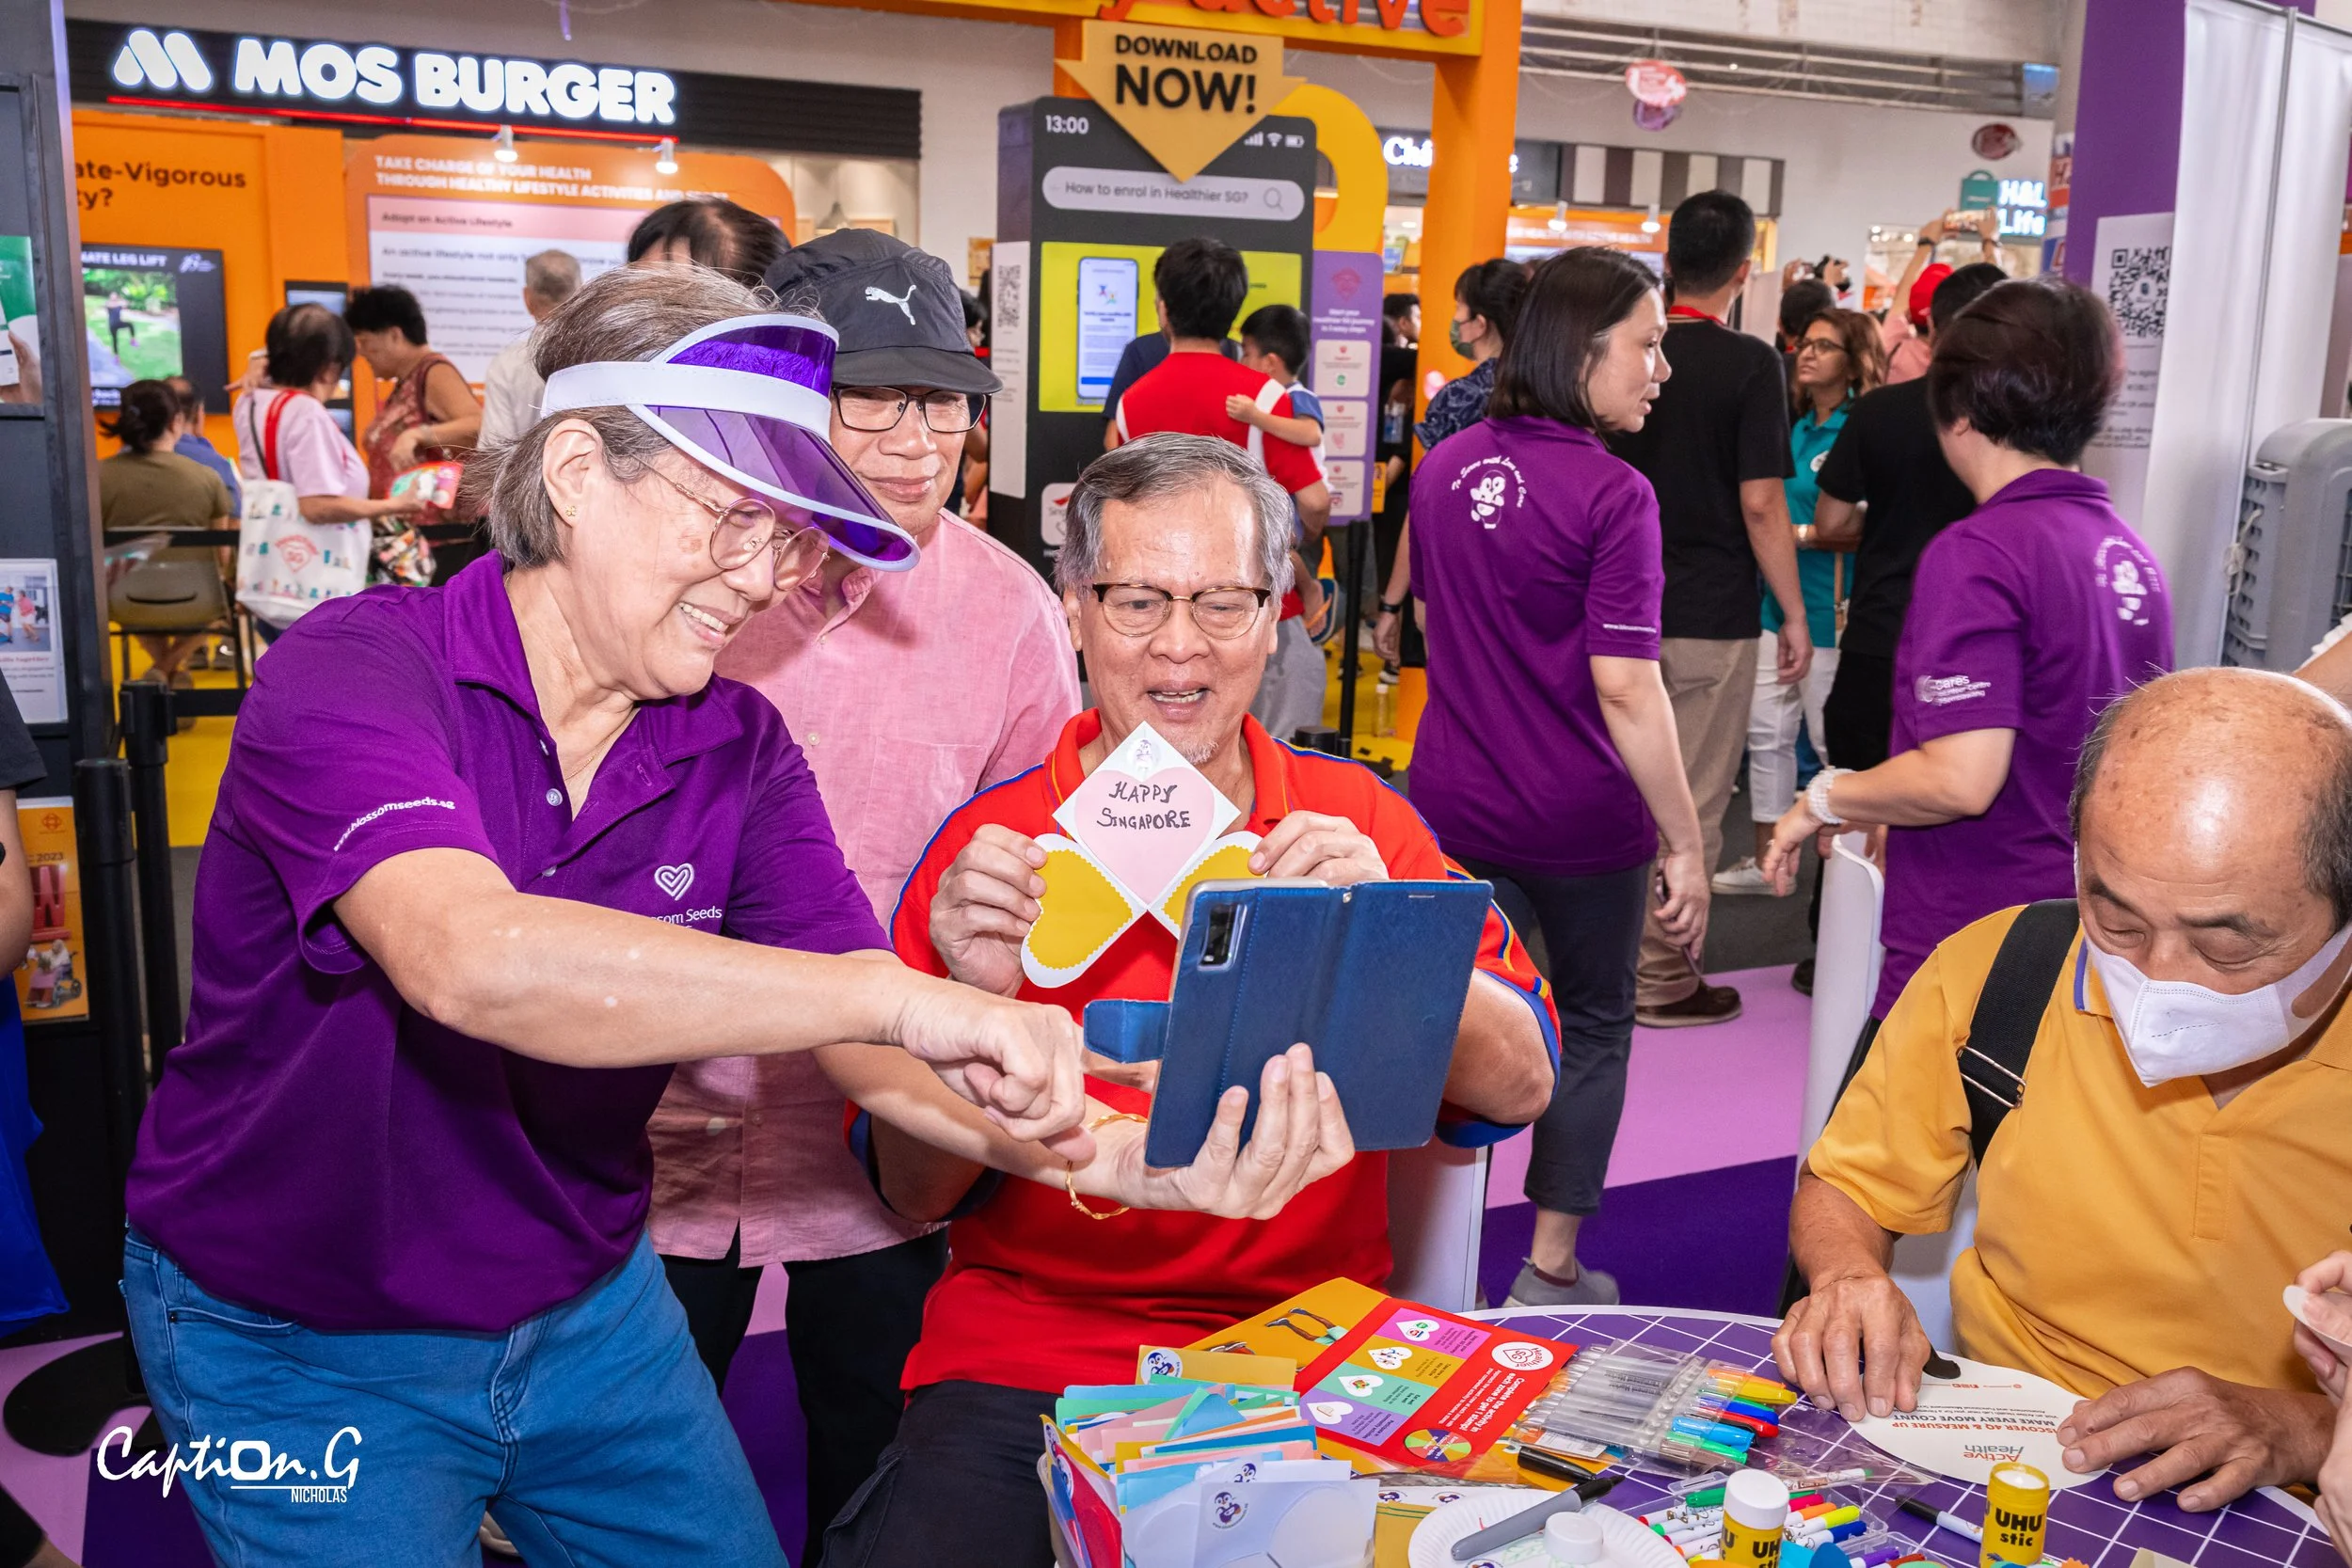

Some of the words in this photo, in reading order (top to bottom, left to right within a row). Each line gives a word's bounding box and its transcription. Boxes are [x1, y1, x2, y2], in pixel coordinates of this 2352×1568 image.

[1116, 34, 1258, 64] DOWNLOAD
[235, 39, 402, 103] MOS
[414, 53, 675, 123] BURGER
[1116, 64, 1257, 115] NOW!
[1045, 115, 1089, 135] 13:00
[75, 161, 246, 188] ate-Vigorous
[375, 155, 412, 170] TAKE
[415, 158, 473, 174] CHARGE
[499, 163, 536, 177] YOUR
[539, 166, 591, 182] HEALTH
[376, 172, 447, 189] THROUGH
[449, 176, 512, 193] HEALTHY
[514, 181, 579, 197] LIFESTYLE
[581, 185, 653, 200] ACTIVITIES
[1065, 182, 1093, 195] How
[1098, 182, 1110, 196] to
[1114, 184, 1147, 198] enrol
[1151, 185, 1163, 198] in
[1165, 187, 1222, 202] Healthier
[1225, 189, 1248, 203] SG?
[1109, 781, 1177, 803] HAPPY
[686, 905, 723, 922] Seeds
[1500, 1371, 1518, 1386] each
[1484, 1395, 1497, 1403] to
[1488, 1383, 1506, 1397] zone
[1497, 1376, 1527, 1402] Complete
[1474, 1401, 1491, 1412] get
[1490, 1399, 1506, 1410] the
[1456, 1412, 1481, 1432] stamp!
[1472, 1407, 1499, 1428] activity
[1979, 1416, 2017, 1424] EVERY
[2019, 1418, 2056, 1427] MAKE
[1469, 1425, 1482, 1433] in
[2005, 1424, 2058, 1433] ISCOVER
[1963, 1451, 2020, 1463] Active
[1965, 1445, 2025, 1454] Health
[1995, 1508, 2044, 1531] UHU
[1752, 1536, 1781, 1559] UH
[2000, 1533, 2033, 1546] stic
